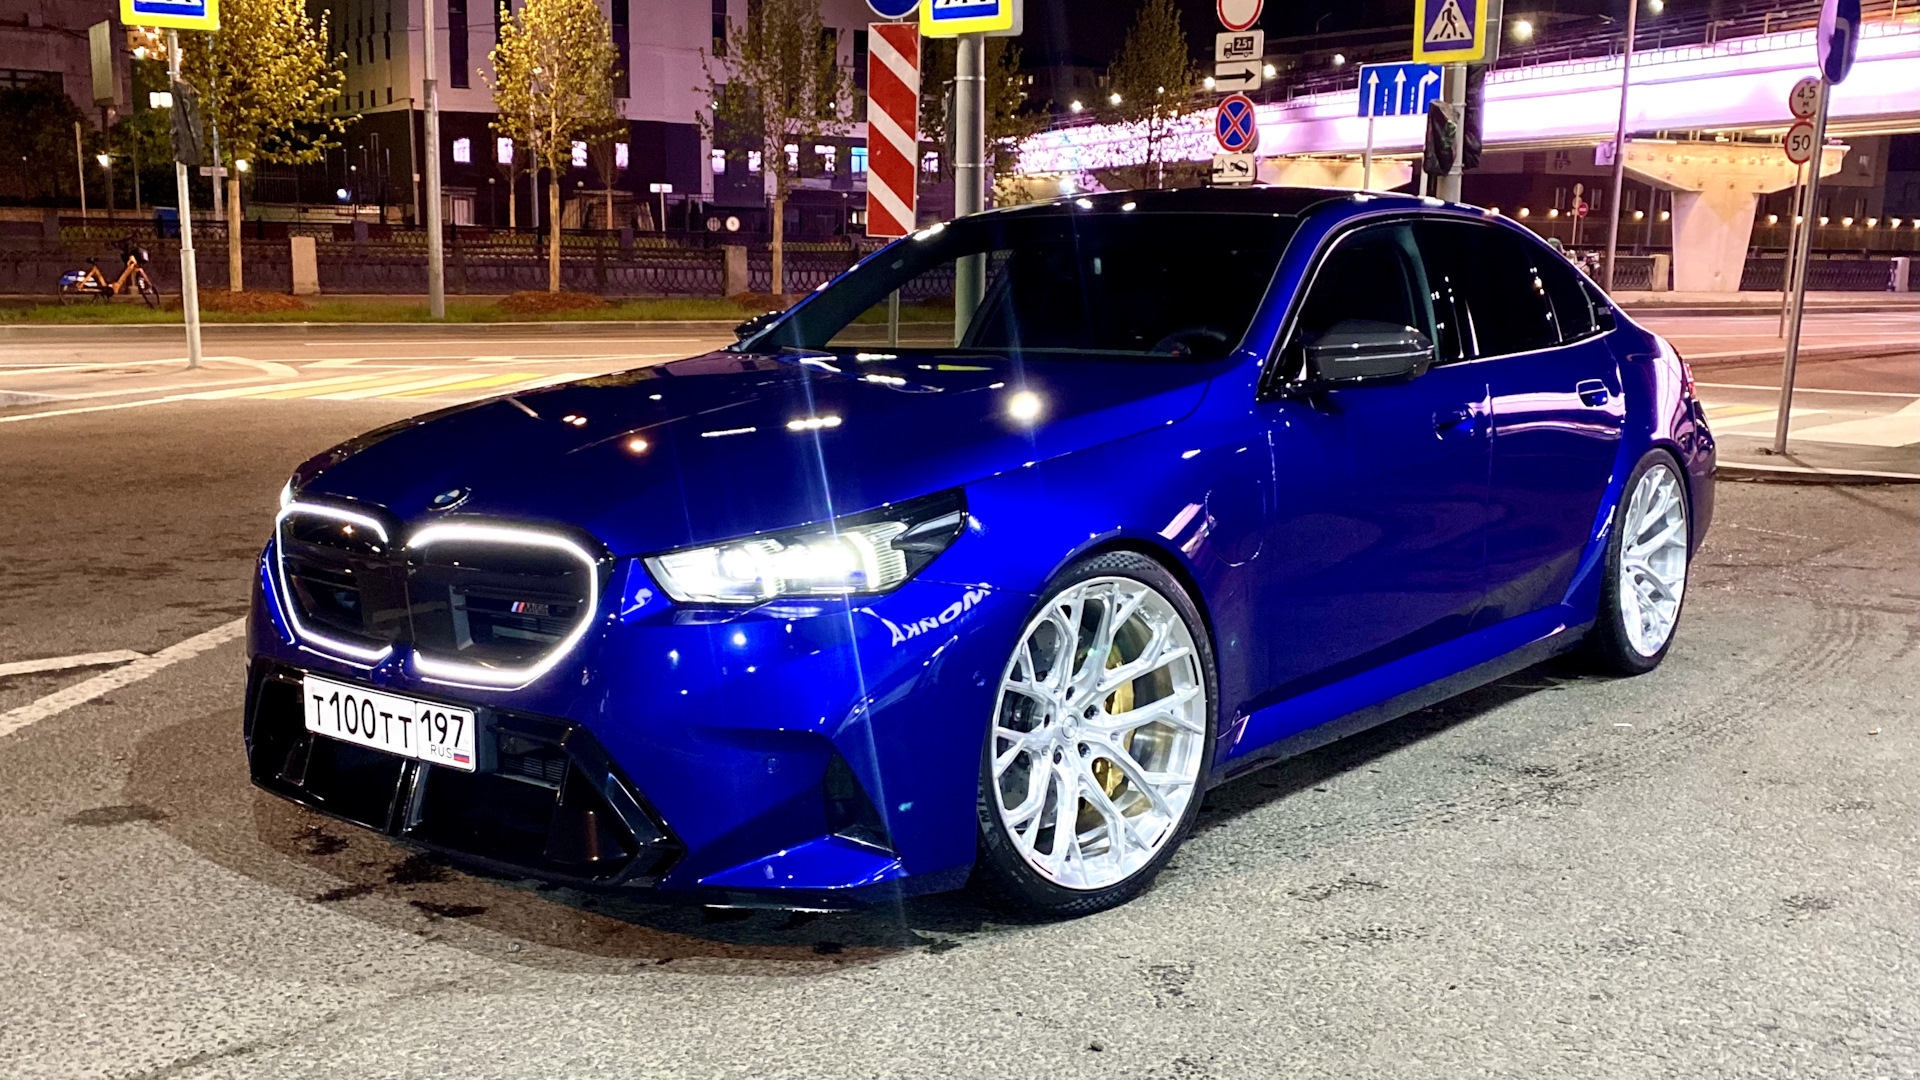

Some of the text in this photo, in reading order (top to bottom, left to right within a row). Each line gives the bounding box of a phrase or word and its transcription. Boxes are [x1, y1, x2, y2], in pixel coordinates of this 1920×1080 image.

[1792, 134, 1811, 152] 50
[420, 709, 464, 748] 197
[430, 744, 453, 759] RUS
